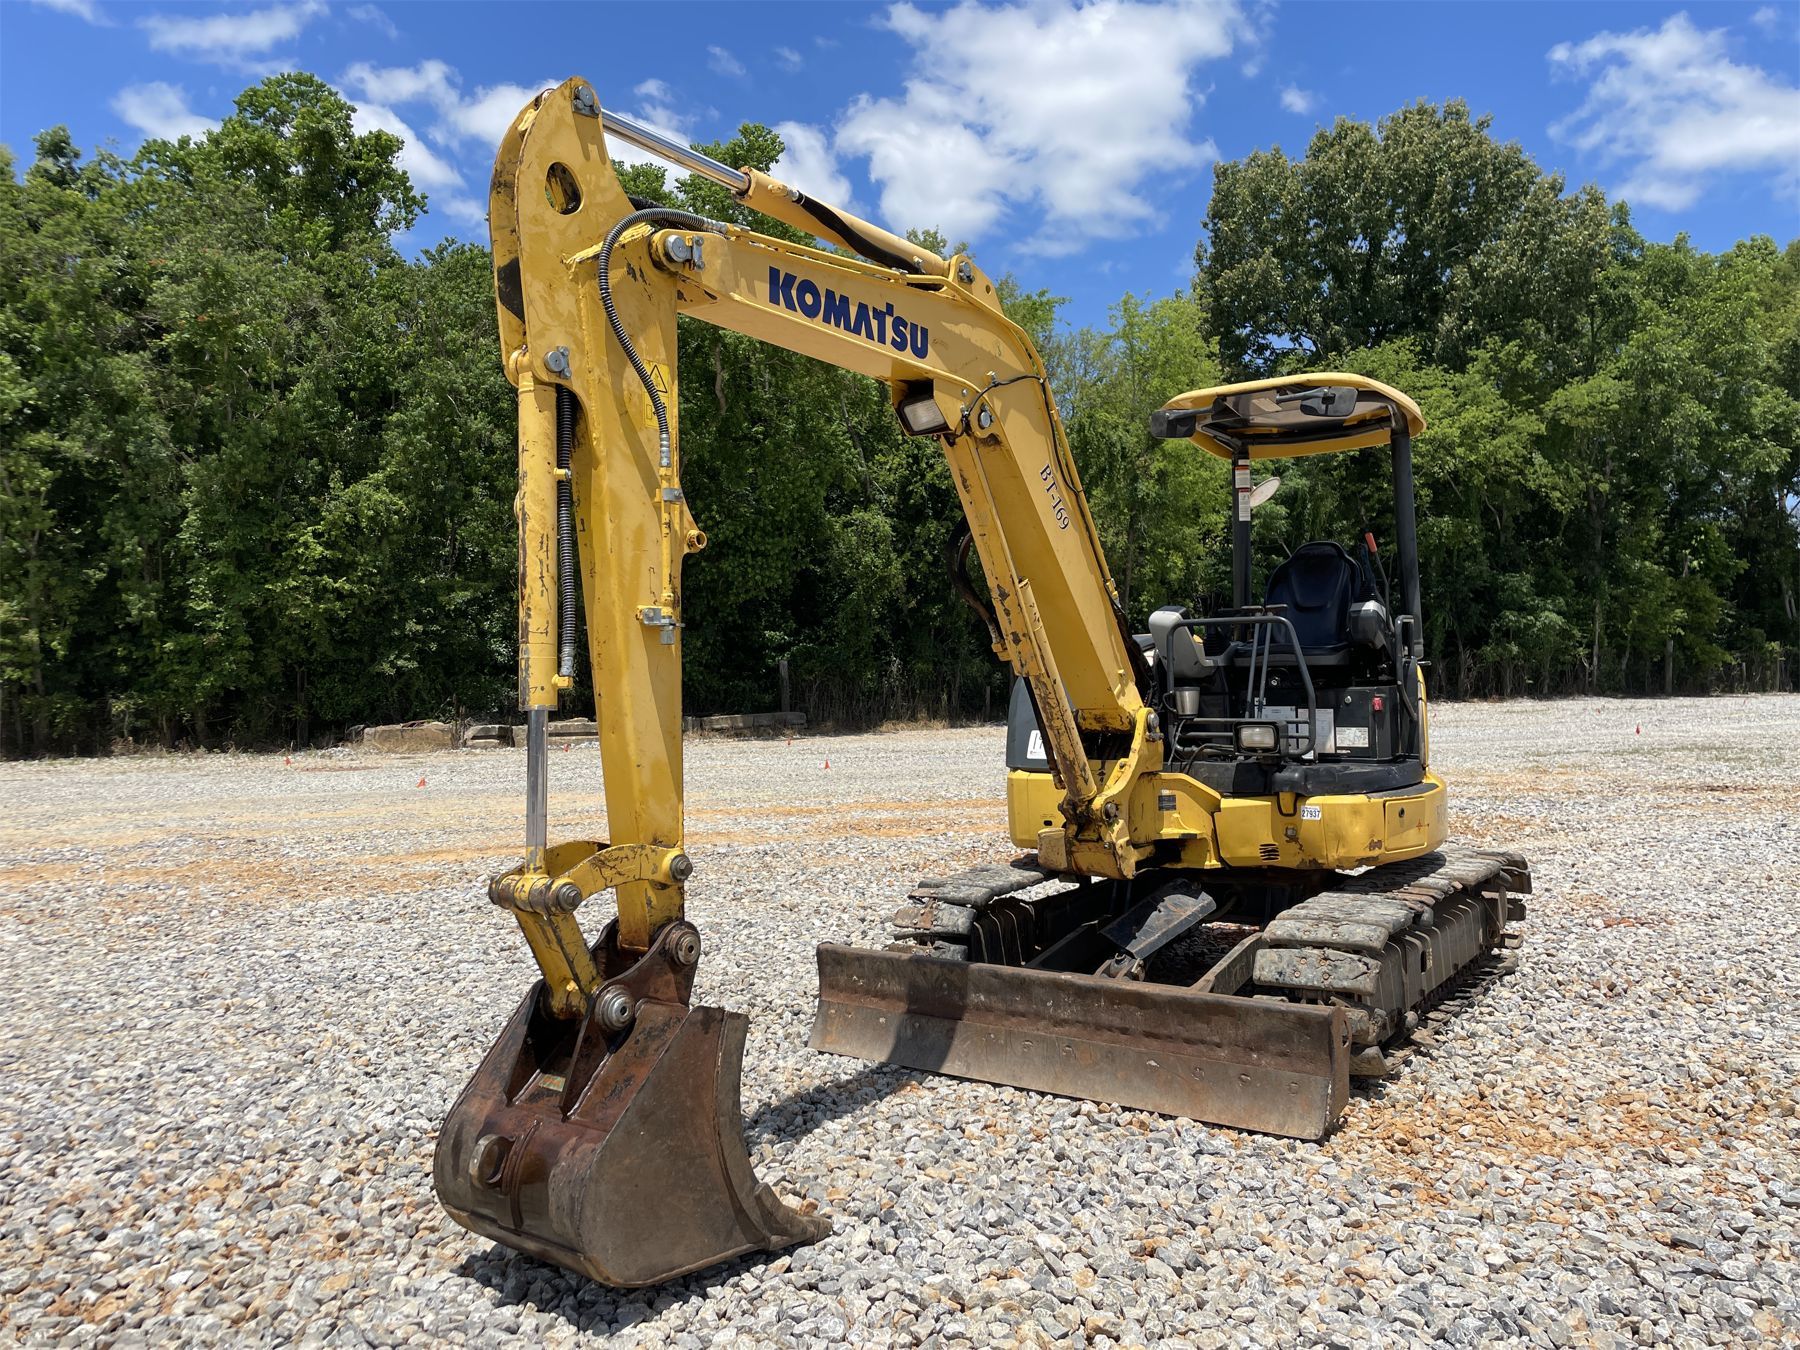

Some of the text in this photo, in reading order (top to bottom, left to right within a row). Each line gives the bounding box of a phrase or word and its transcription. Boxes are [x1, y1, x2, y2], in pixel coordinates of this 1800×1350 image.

[769, 266, 929, 359] KOMATSU
[1040, 464, 1070, 530] BT-169
[1301, 809, 1321, 818] 27937
